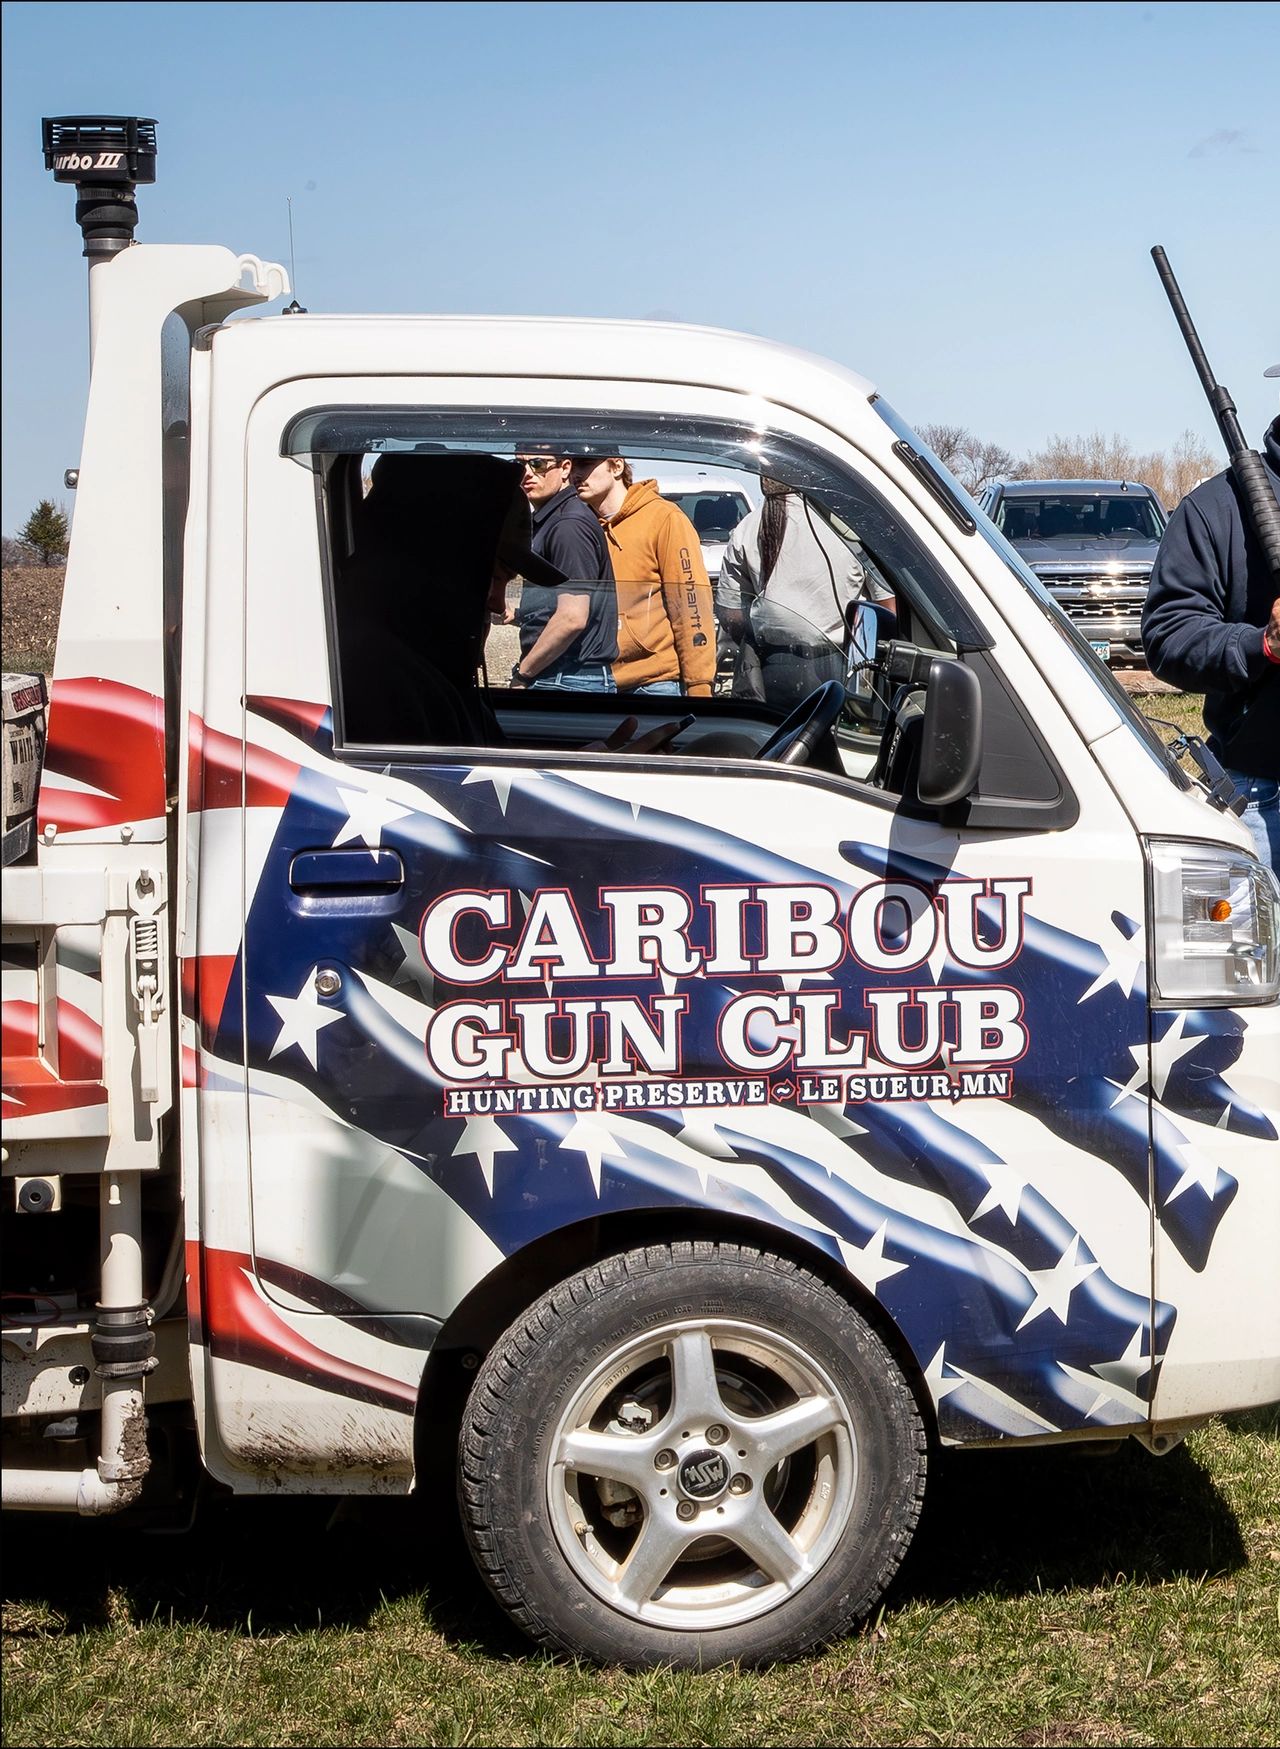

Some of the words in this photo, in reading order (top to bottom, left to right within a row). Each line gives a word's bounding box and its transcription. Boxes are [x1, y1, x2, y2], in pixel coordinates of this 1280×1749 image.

[679, 547, 702, 630] carhartt
[420, 878, 1031, 984] CARIBOU
[426, 996, 688, 1080] GUN
[718, 986, 1028, 1072] CLUB
[448, 1085, 595, 1114] HUNTING
[604, 1080, 766, 1107] PRESERVE
[801, 1078, 840, 1101] LE
[849, 1072, 1008, 1100] SUEUR,MN
[685, 1455, 724, 1490] MSW
